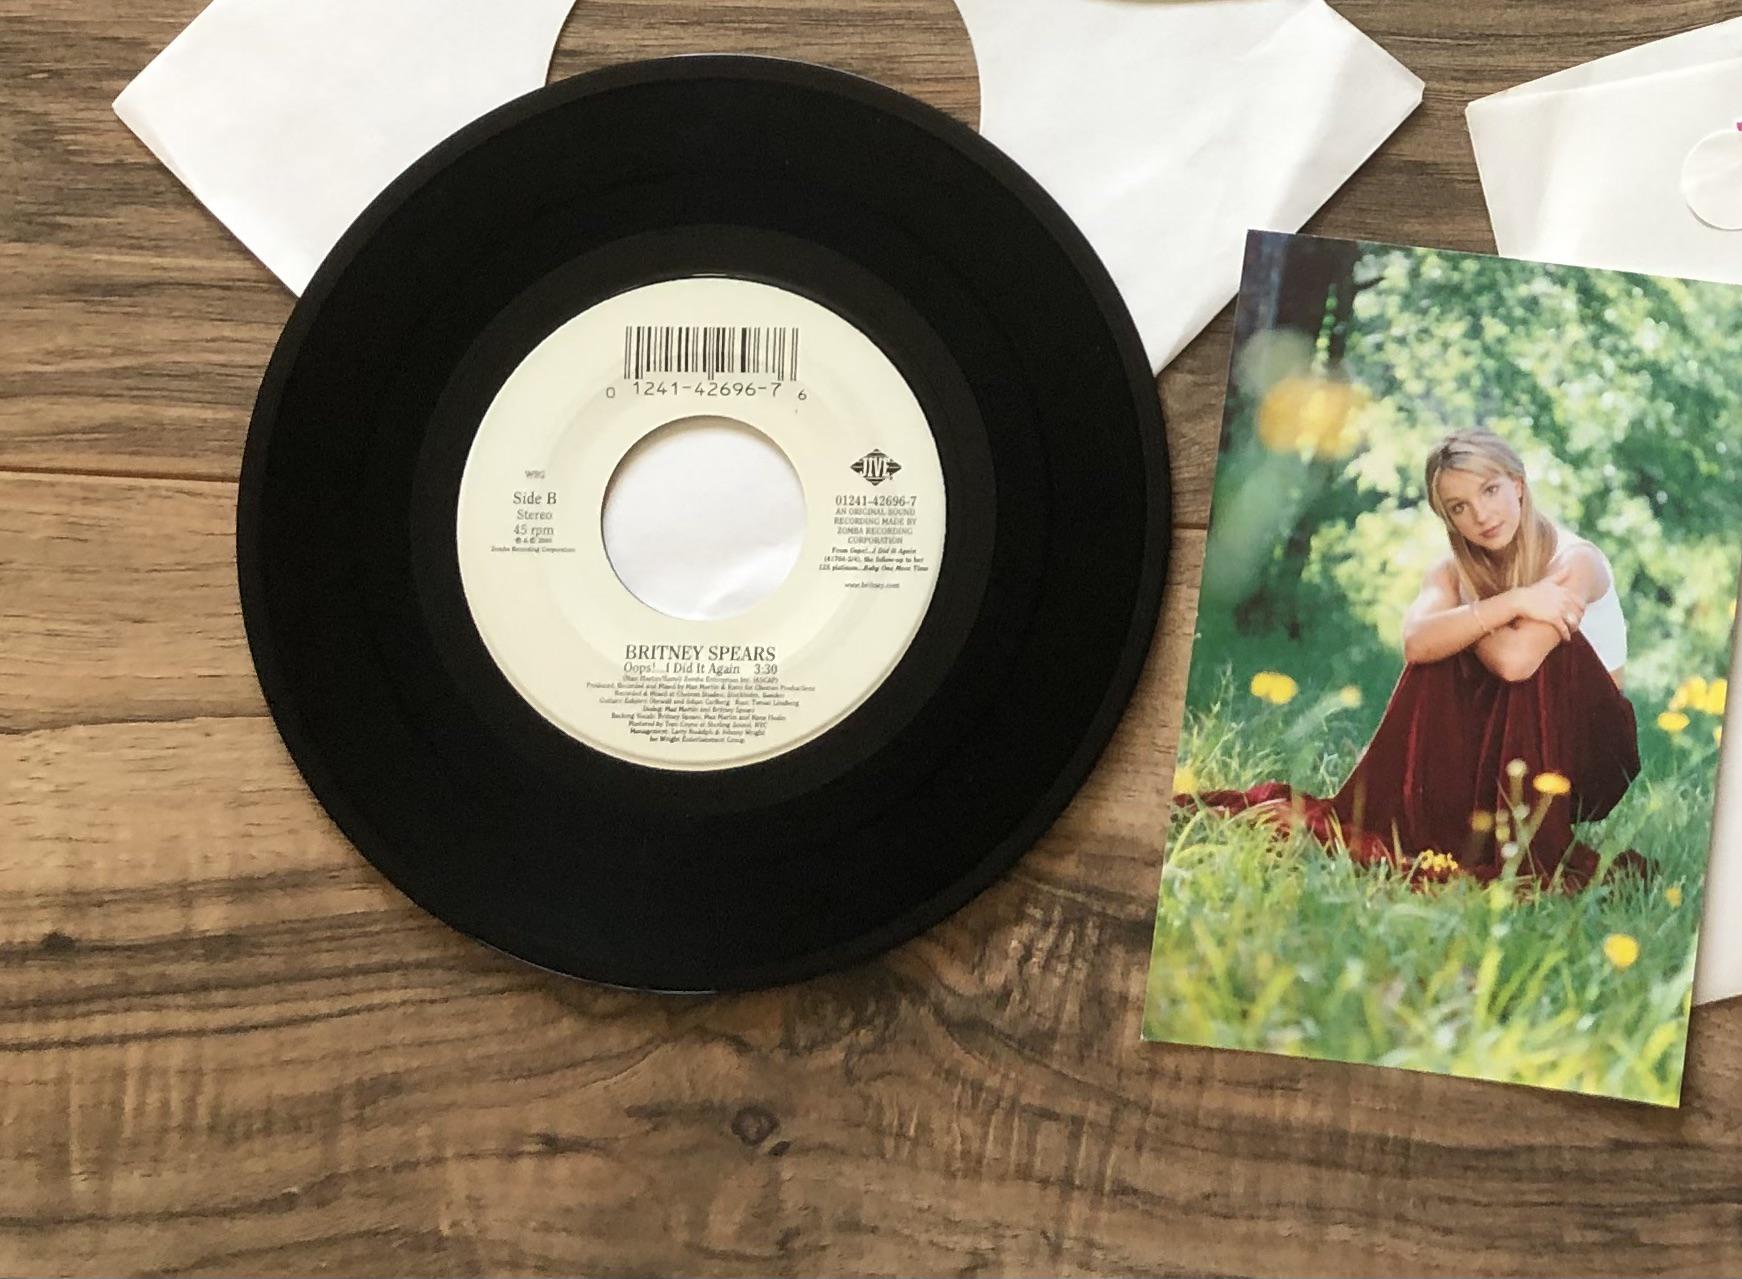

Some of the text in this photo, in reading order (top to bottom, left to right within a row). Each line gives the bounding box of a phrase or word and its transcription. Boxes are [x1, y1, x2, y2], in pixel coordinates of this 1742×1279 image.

[605, 380, 808, 402] 0 1241-42696-7 6
[860, 456, 891, 479] JIVE
[512, 490, 558, 506] Side B
[834, 494, 918, 508] 01241-42696-7
[516, 508, 553, 521] Stereo
[513, 523, 555, 538] 45 rpm
[624, 644, 777, 662] BRITNEY SPEARS
[673, 662, 694, 675] Did
[696, 662, 706, 674] It
[708, 662, 741, 677] Again
[753, 663, 779, 676] 3:30
